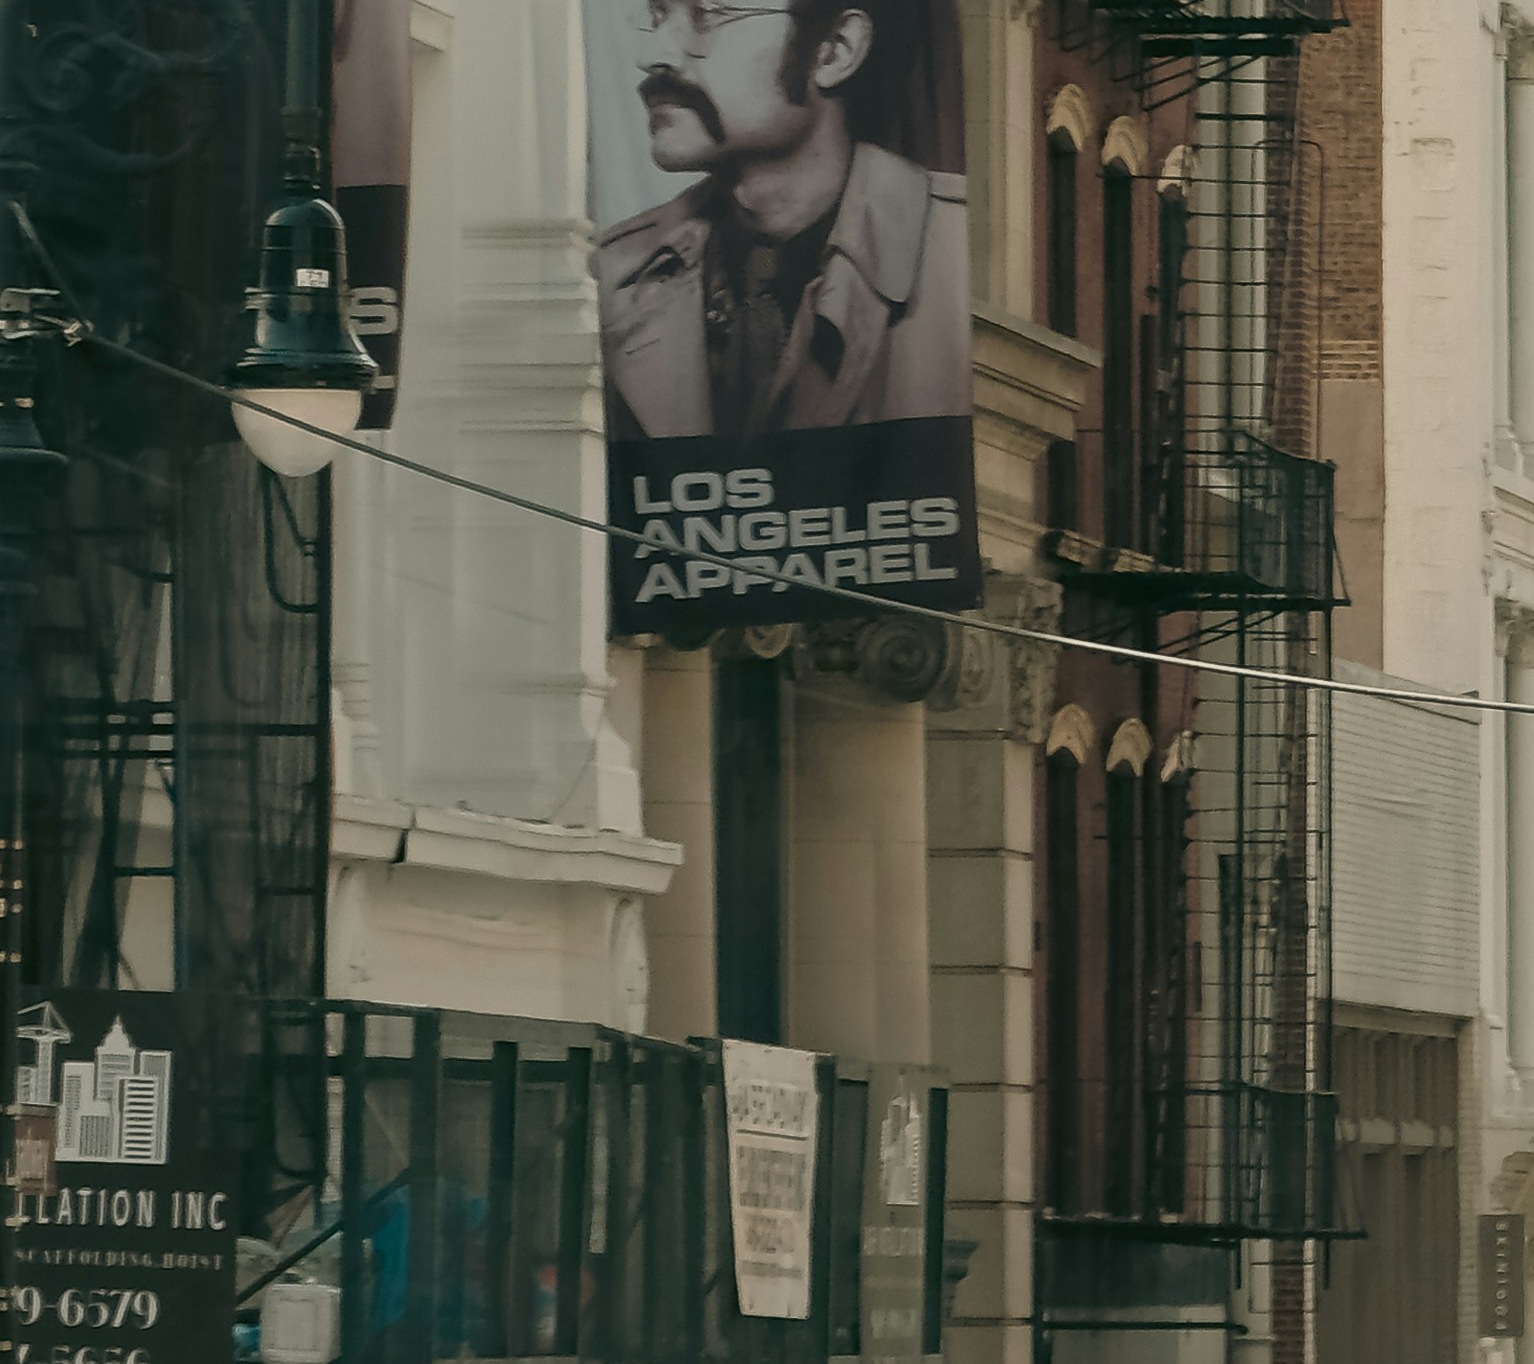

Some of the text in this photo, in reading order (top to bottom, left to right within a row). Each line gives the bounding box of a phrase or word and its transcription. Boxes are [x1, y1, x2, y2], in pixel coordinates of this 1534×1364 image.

[633, 469, 773, 516] LOS
[634, 496, 960, 560] ANGELES
[635, 541, 958, 604] APPAREL
[171, 1191, 227, 1230] INC
